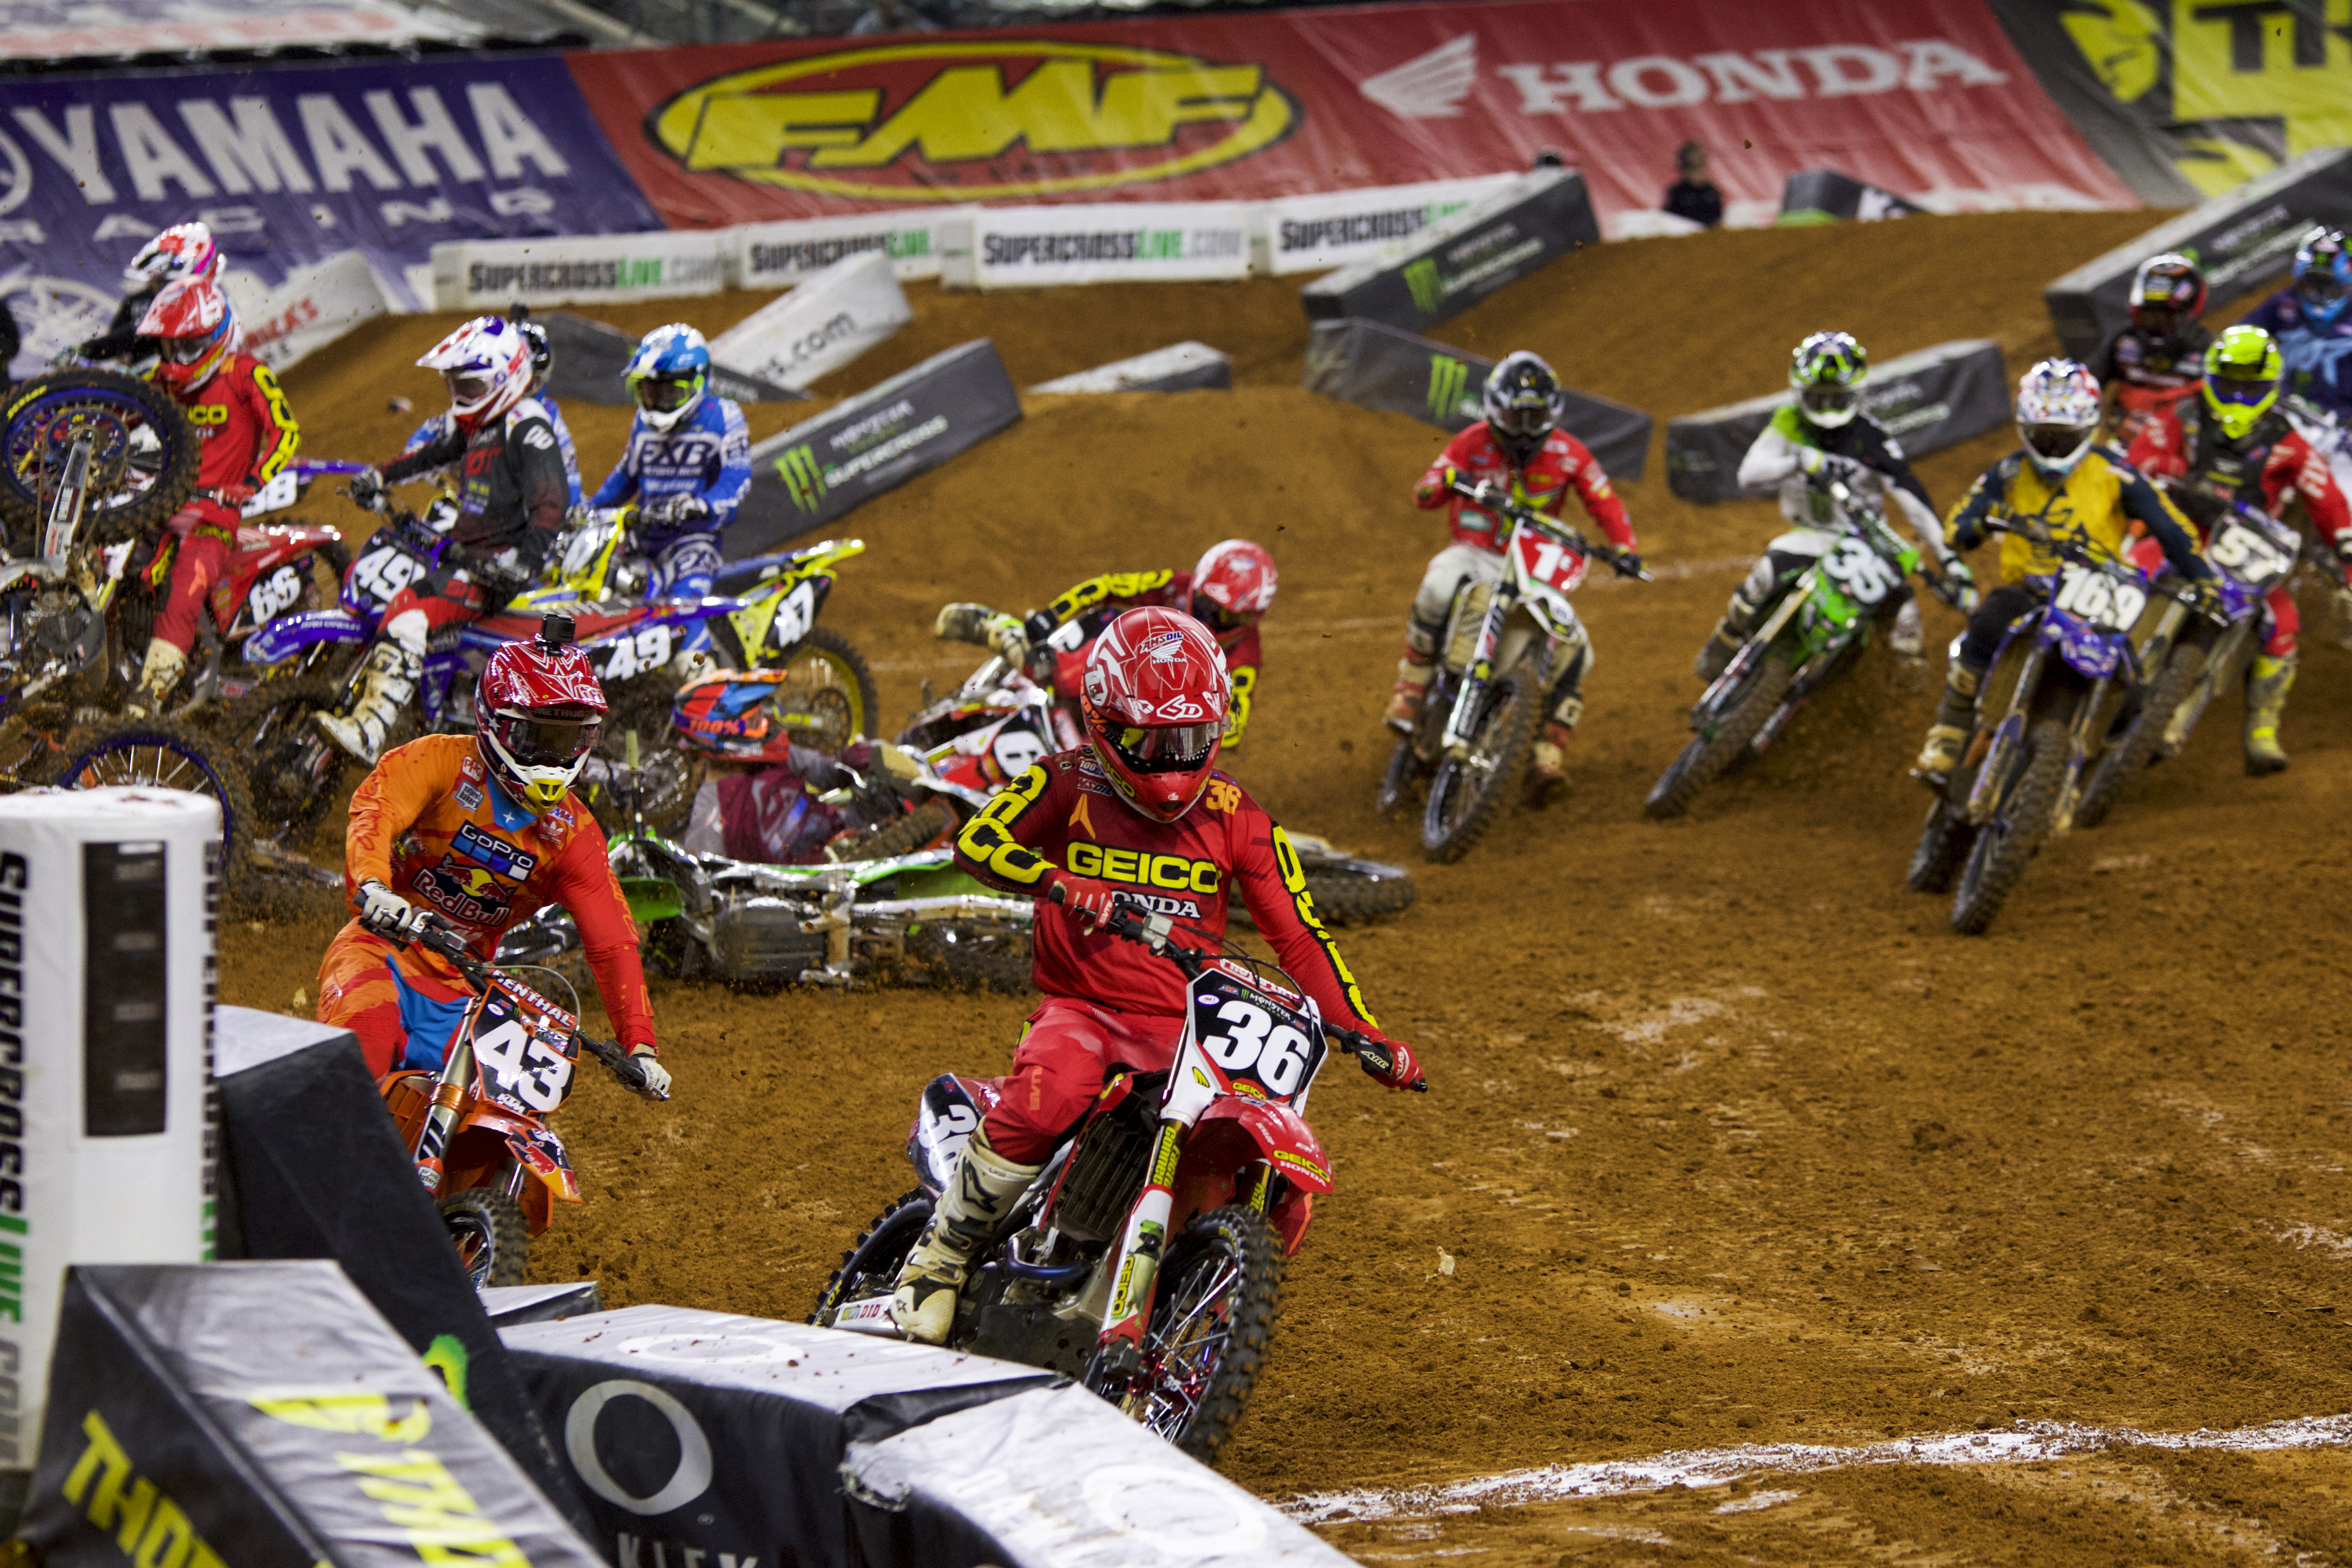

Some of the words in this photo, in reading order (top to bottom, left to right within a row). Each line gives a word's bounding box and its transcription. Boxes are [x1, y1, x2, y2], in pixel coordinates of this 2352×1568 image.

[1495, 40, 2008, 114] HONDA
[12, 82, 571, 204] YAMAHA
[683, 57, 1263, 173] FMF
[2054, 570, 2147, 634] 169
[605, 624, 671, 680] 49
[1206, 779, 1242, 816] 36
[461, 824, 533, 869] GoPro
[1067, 842, 1222, 894] GEICO
[412, 868, 466, 913] Red
[456, 898, 510, 926] Bull
[1111, 890, 1201, 919] ONDA
[1250, 993, 1291, 1020] MONSTER
[475, 1019, 572, 1112] 43
[1202, 1000, 1311, 1096] 36
[496, 1093, 526, 1115] KTM
[1232, 1081, 1267, 1100] GEICO
[1273, 1150, 1331, 1183] GEICO
[1280, 1161, 1327, 1188] HONDA
[1112, 1255, 1136, 1316] GEICO
[61, 1410, 231, 1568] THO
